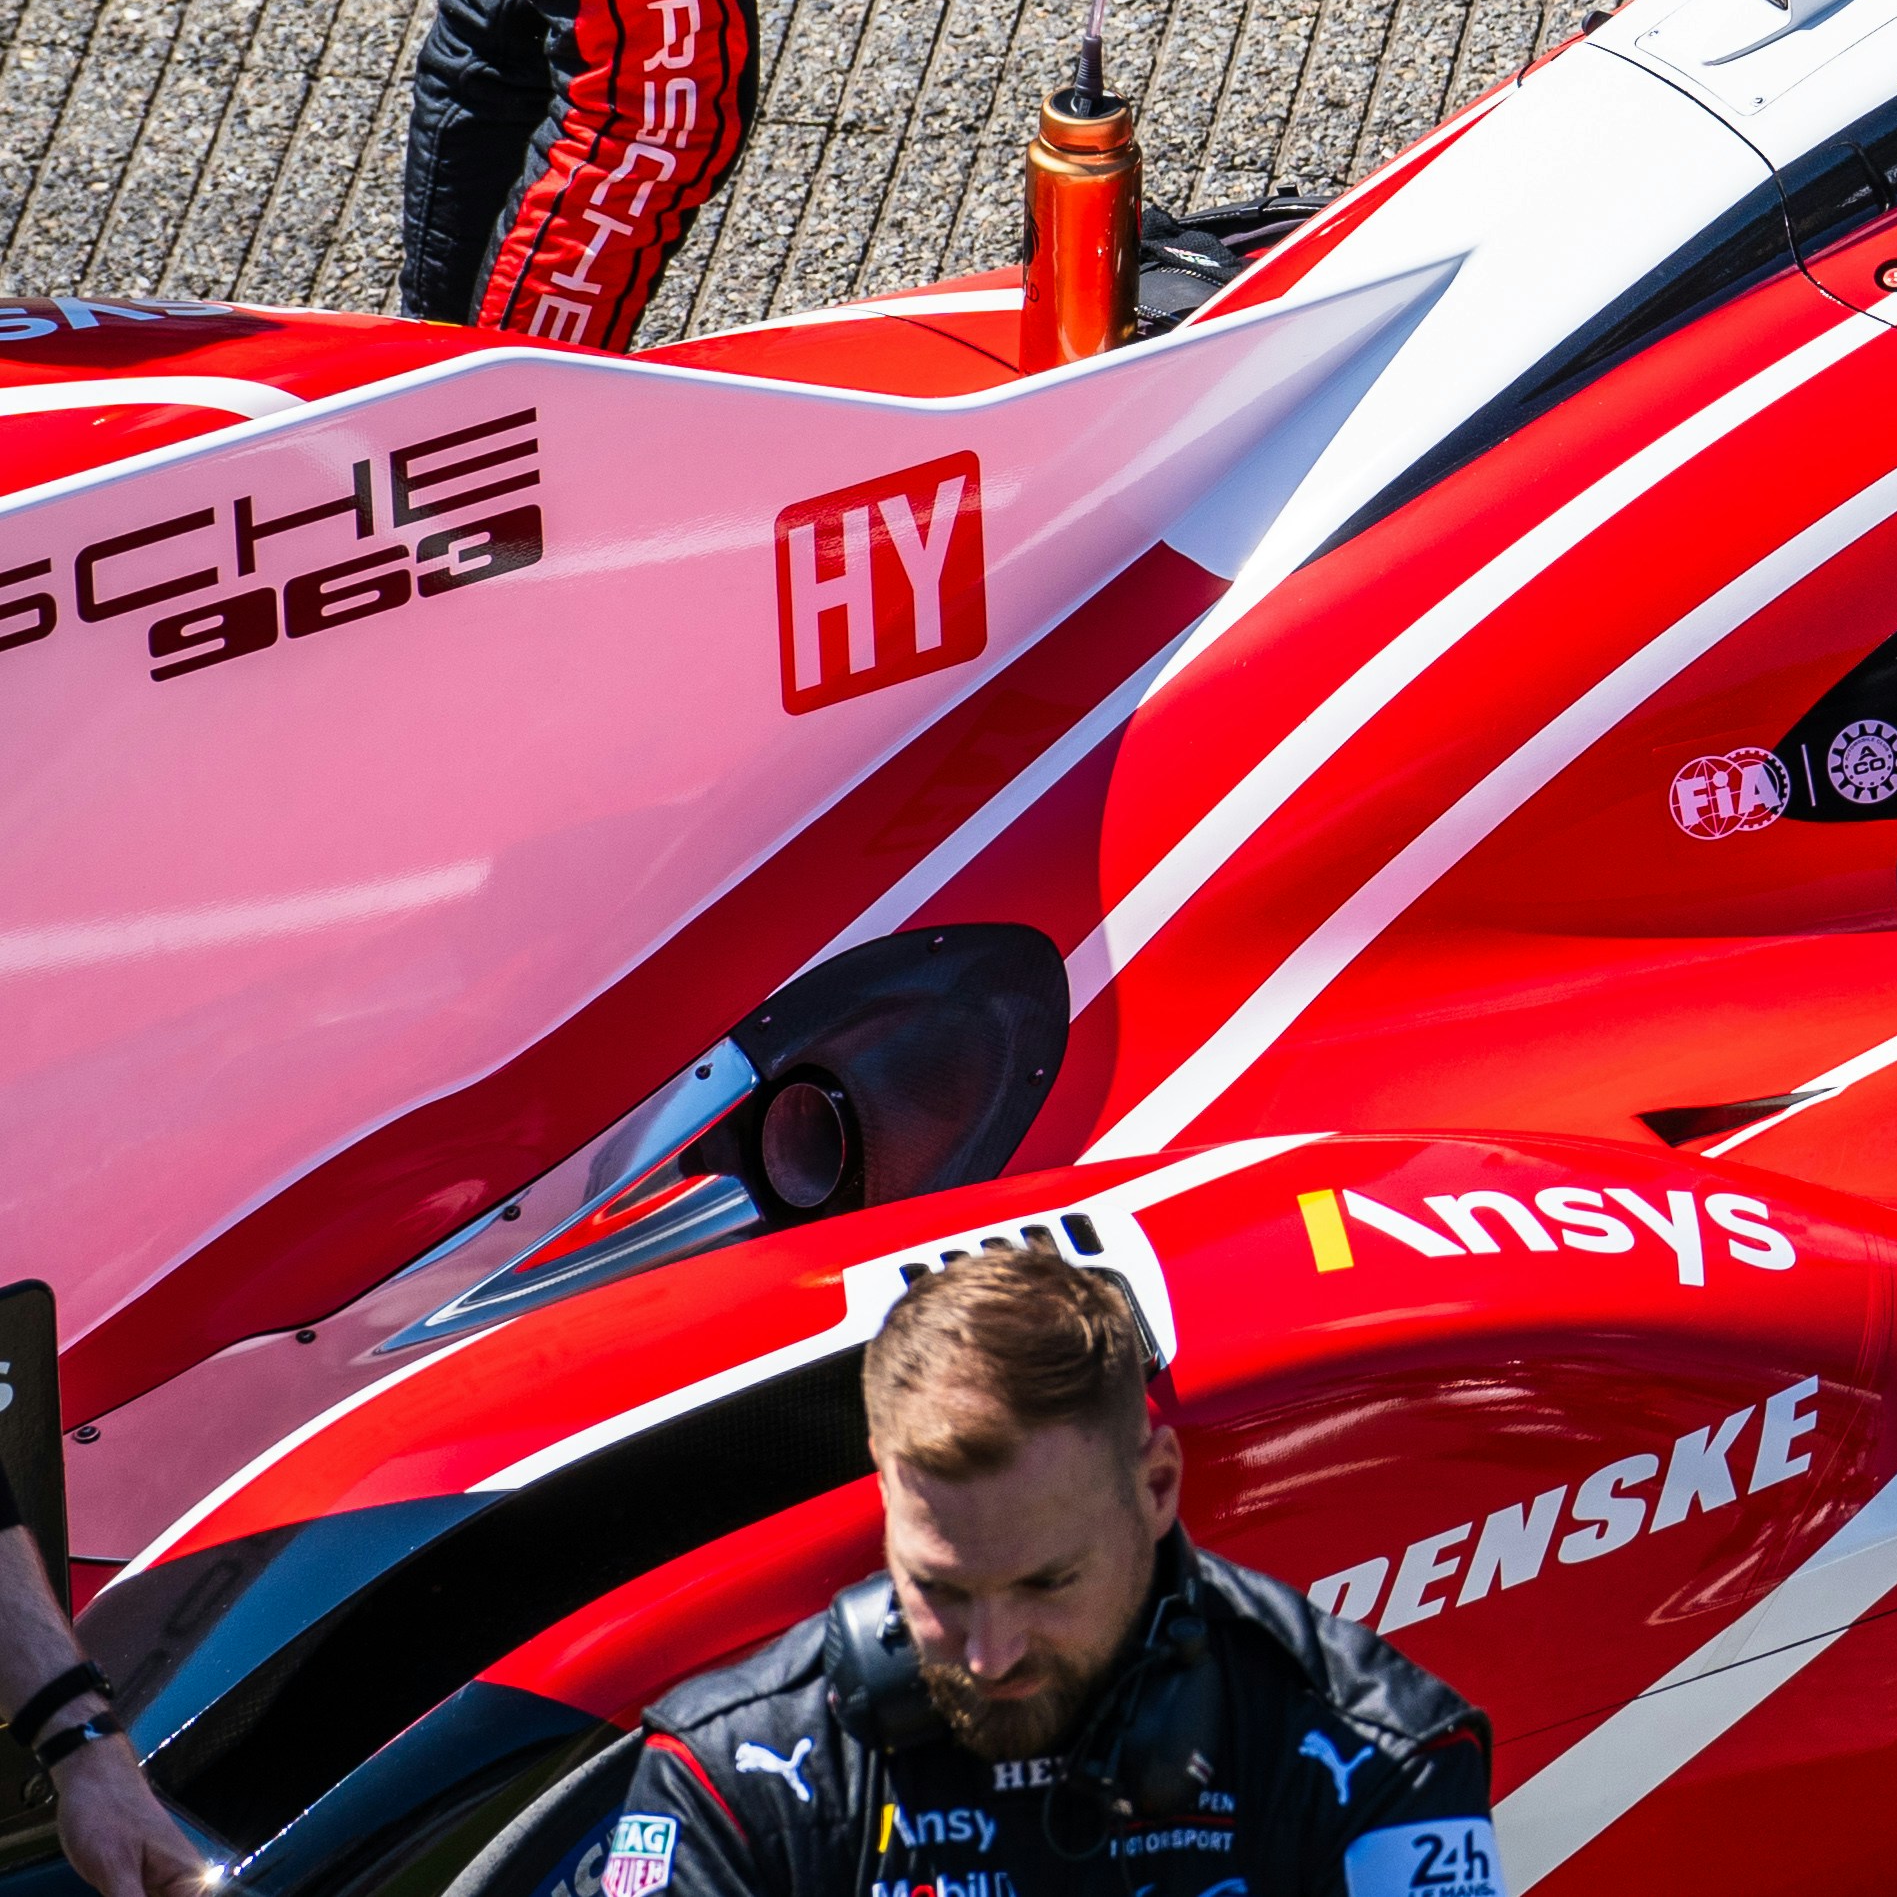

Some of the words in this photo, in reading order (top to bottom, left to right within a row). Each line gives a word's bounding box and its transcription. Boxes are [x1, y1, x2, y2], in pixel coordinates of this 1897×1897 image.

[147, 503, 544, 682] 963
[788, 474, 969, 695] HY
[1296, 1182, 1798, 1288] Ansys
[1307, 1374, 1822, 1636] PENSKE
[1409, 1829, 1490, 1889] 24h
